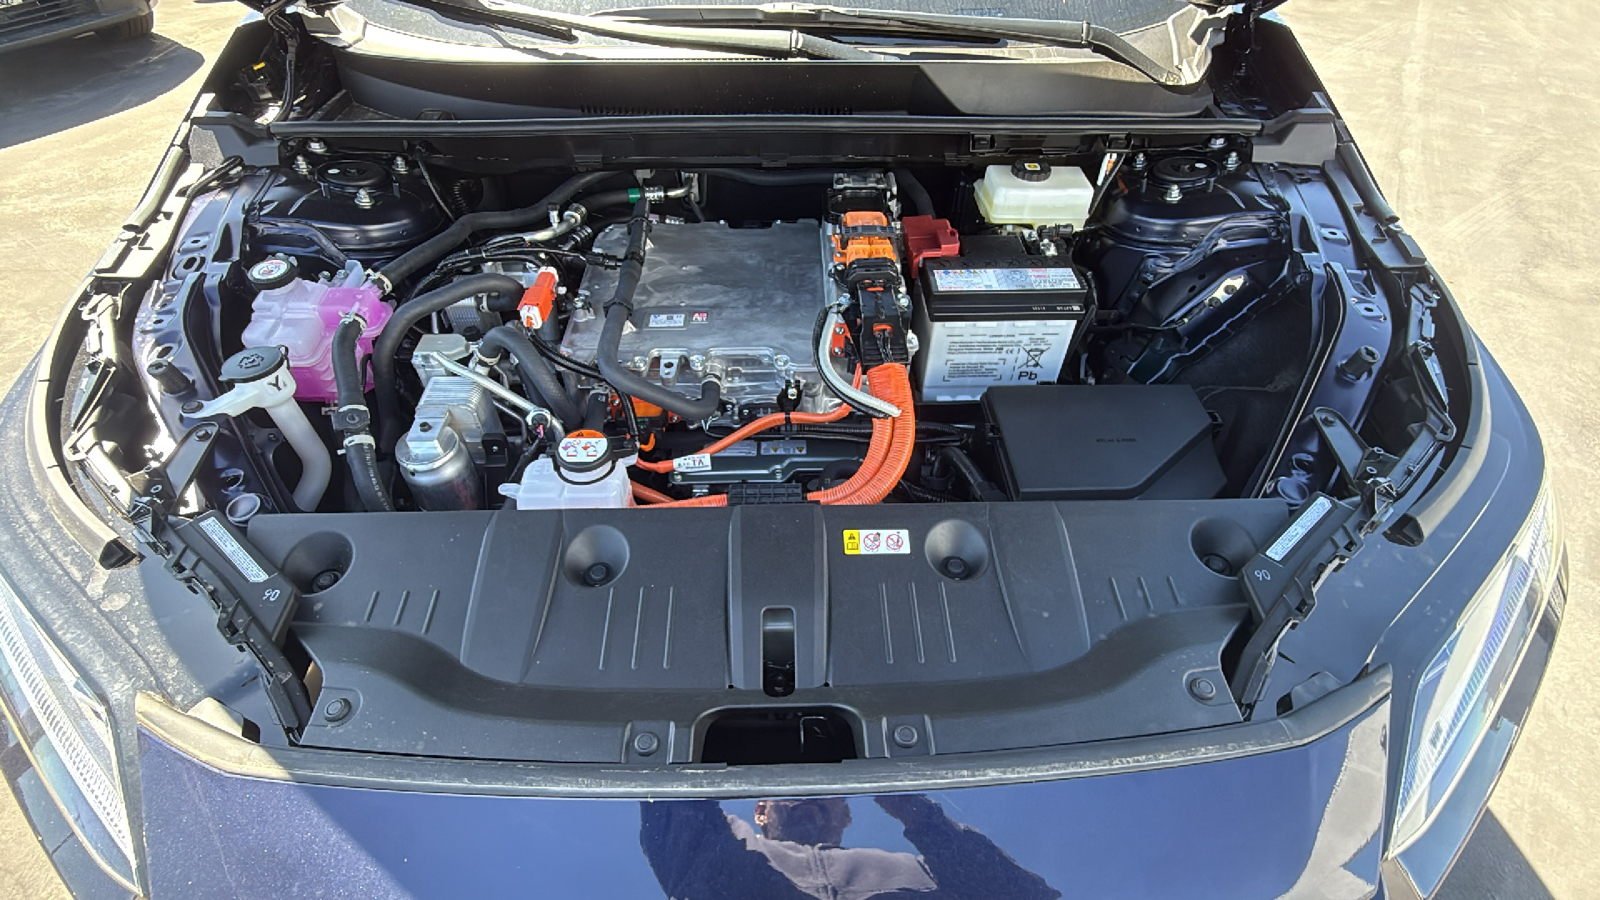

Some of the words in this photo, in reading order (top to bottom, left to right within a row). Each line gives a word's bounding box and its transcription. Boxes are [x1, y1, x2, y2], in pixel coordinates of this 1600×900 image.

[1018, 371, 1038, 380] Pb
[1254, 569, 1271, 580] 90
[263, 588, 280, 601] 90
